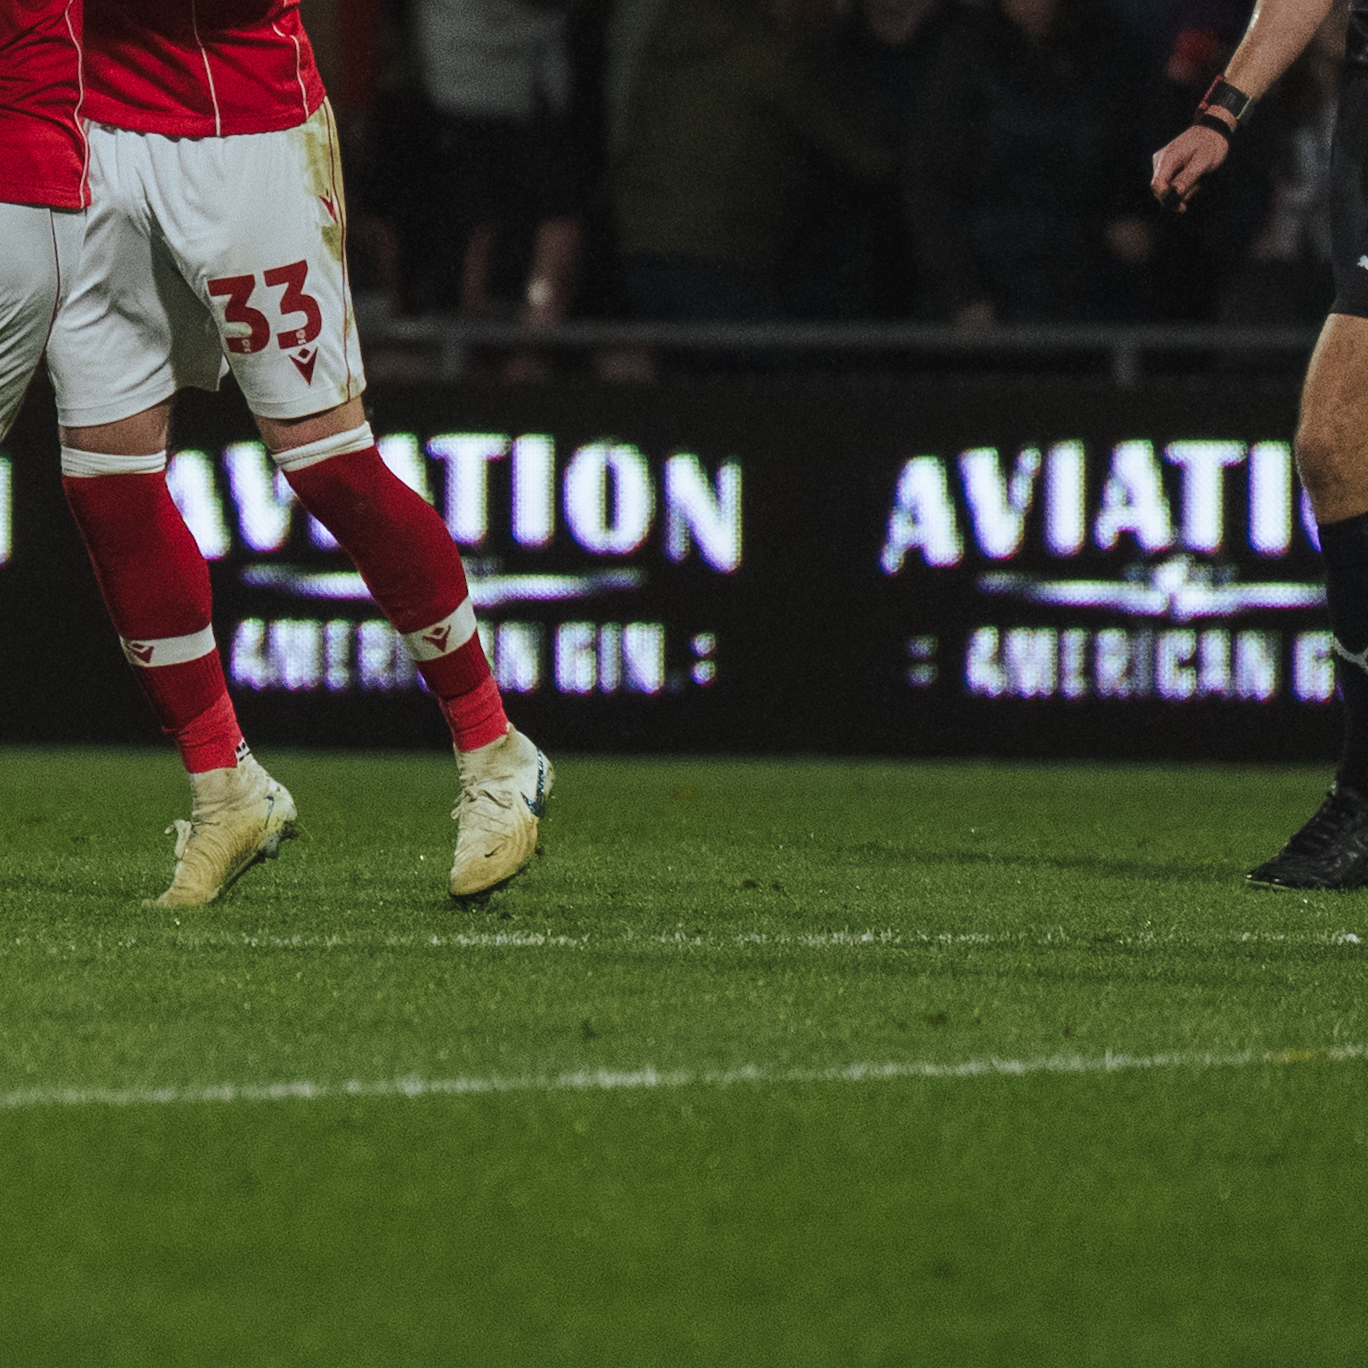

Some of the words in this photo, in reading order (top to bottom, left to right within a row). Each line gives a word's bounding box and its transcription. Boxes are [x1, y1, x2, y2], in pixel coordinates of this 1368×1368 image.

[207, 259, 322, 354] 33
[165, 431, 744, 573] AVTION
[879, 438, 1321, 575] AVIATI
[965, 624, 1281, 701] AMERICAN
